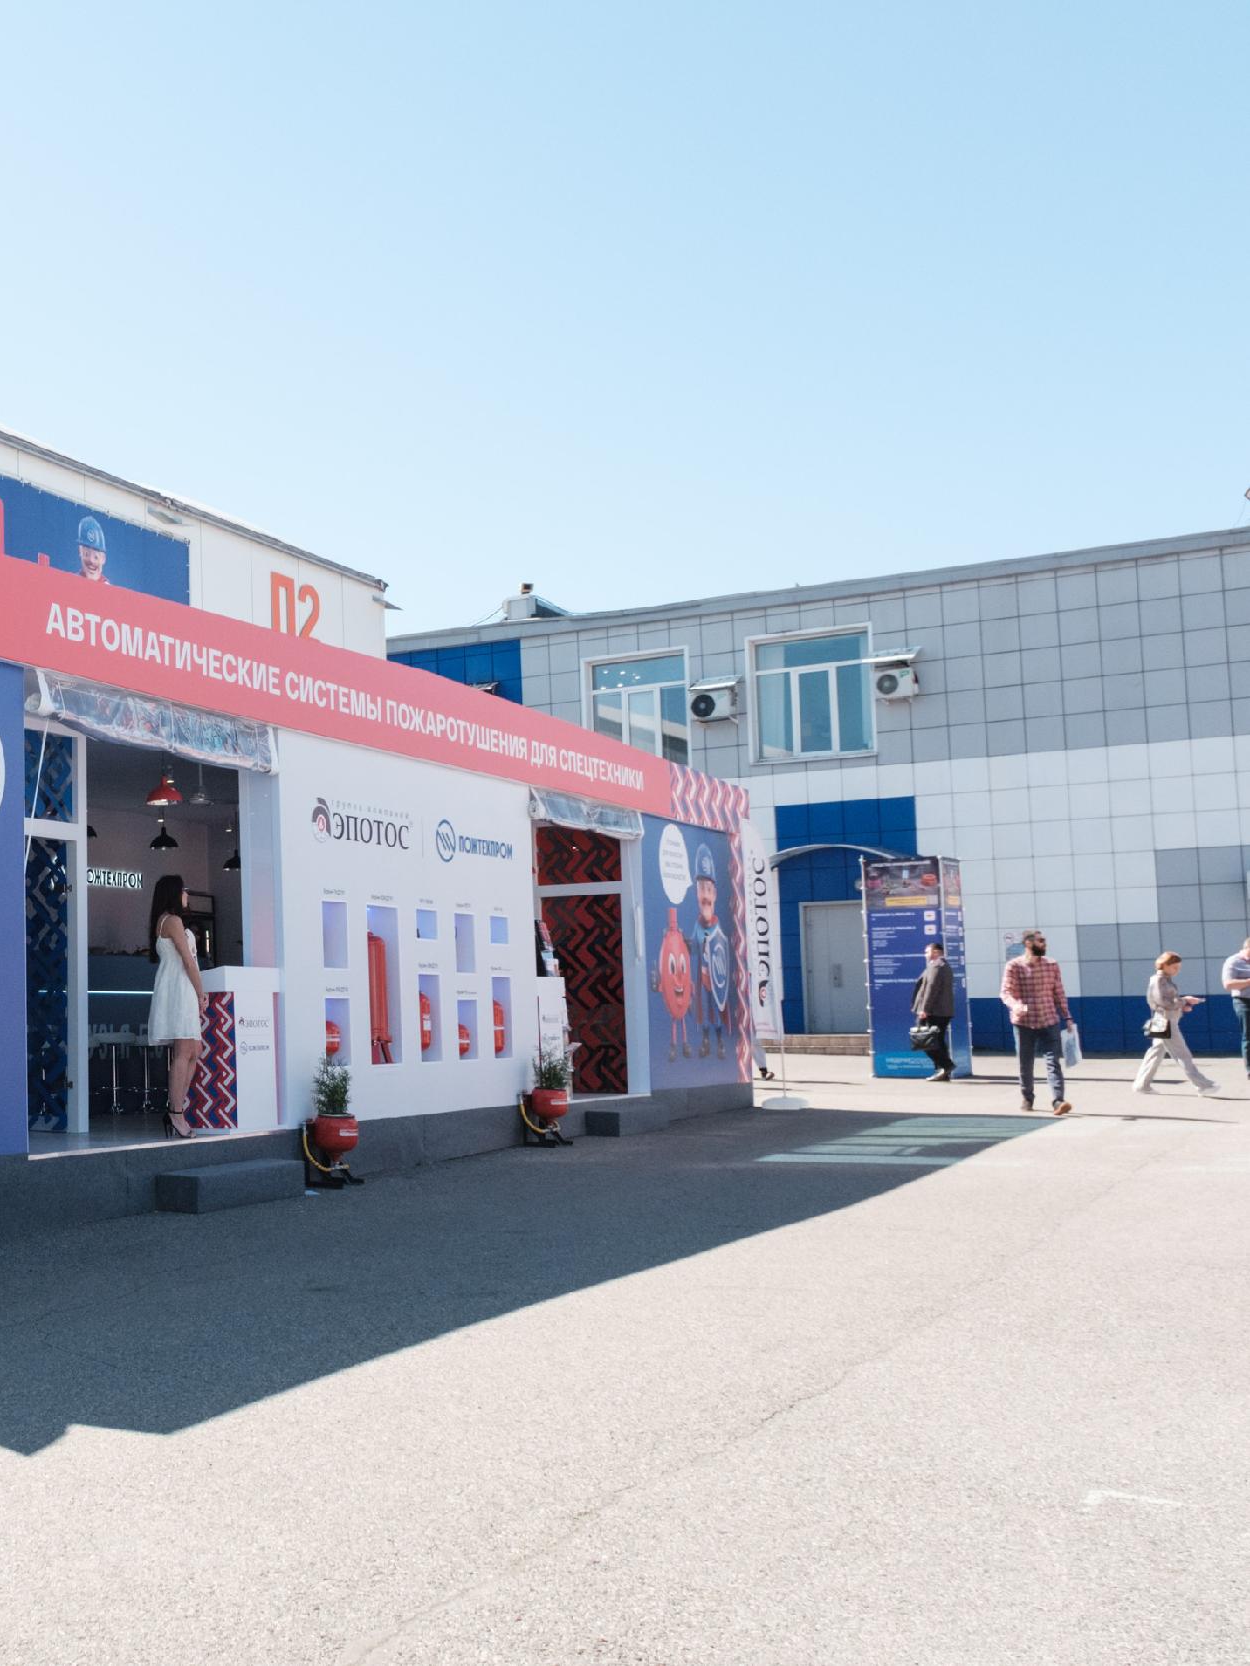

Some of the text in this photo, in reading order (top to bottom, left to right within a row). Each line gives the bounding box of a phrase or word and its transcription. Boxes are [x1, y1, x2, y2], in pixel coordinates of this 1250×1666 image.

[270, 571, 320, 641] П2
[46, 602, 644, 792] АВТОМАТИЧЕСКИЕ СИСТЕМЫ ПОЖАРОТУШЕНИЯ ДЛЯ СПЕЦТЕХНИКИ
[458, 835, 513, 861] ПОЖТЕХПРОМ
